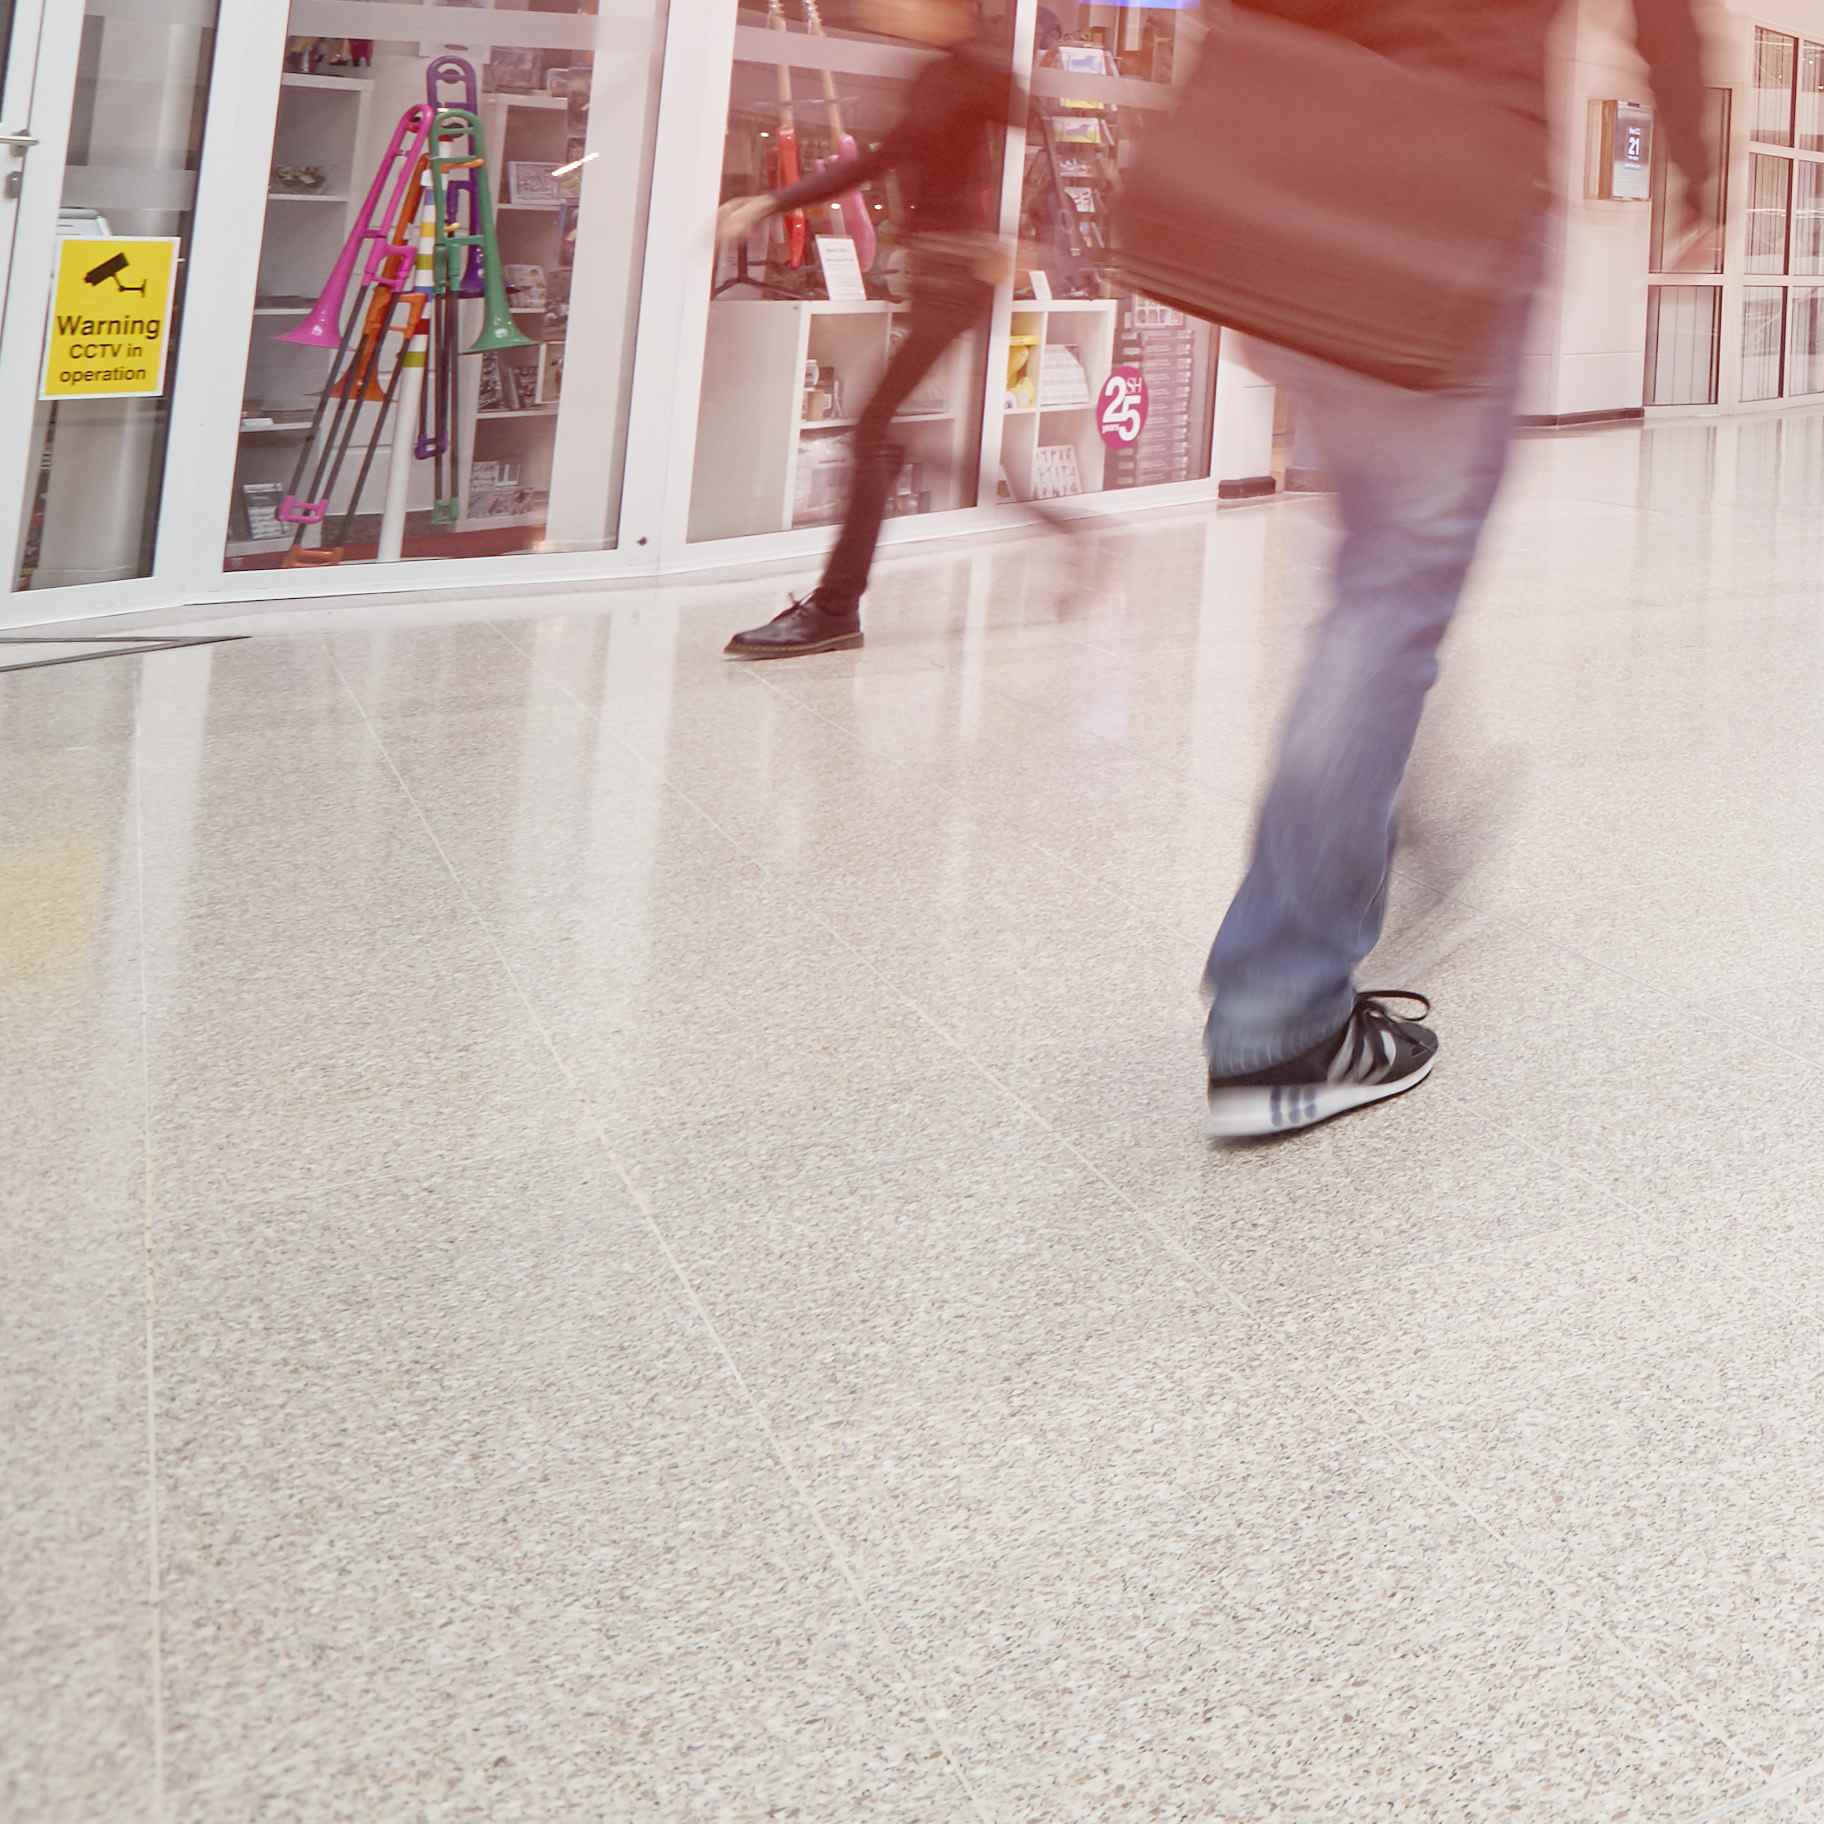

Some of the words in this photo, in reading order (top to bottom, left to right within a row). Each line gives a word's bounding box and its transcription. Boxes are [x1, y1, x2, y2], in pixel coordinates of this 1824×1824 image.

[57, 315, 160, 339] Warning
[69, 343, 123, 359] CCTV
[128, 343, 142, 358] in
[59, 366, 147, 386] operation
[1102, 375, 1141, 441] 25
